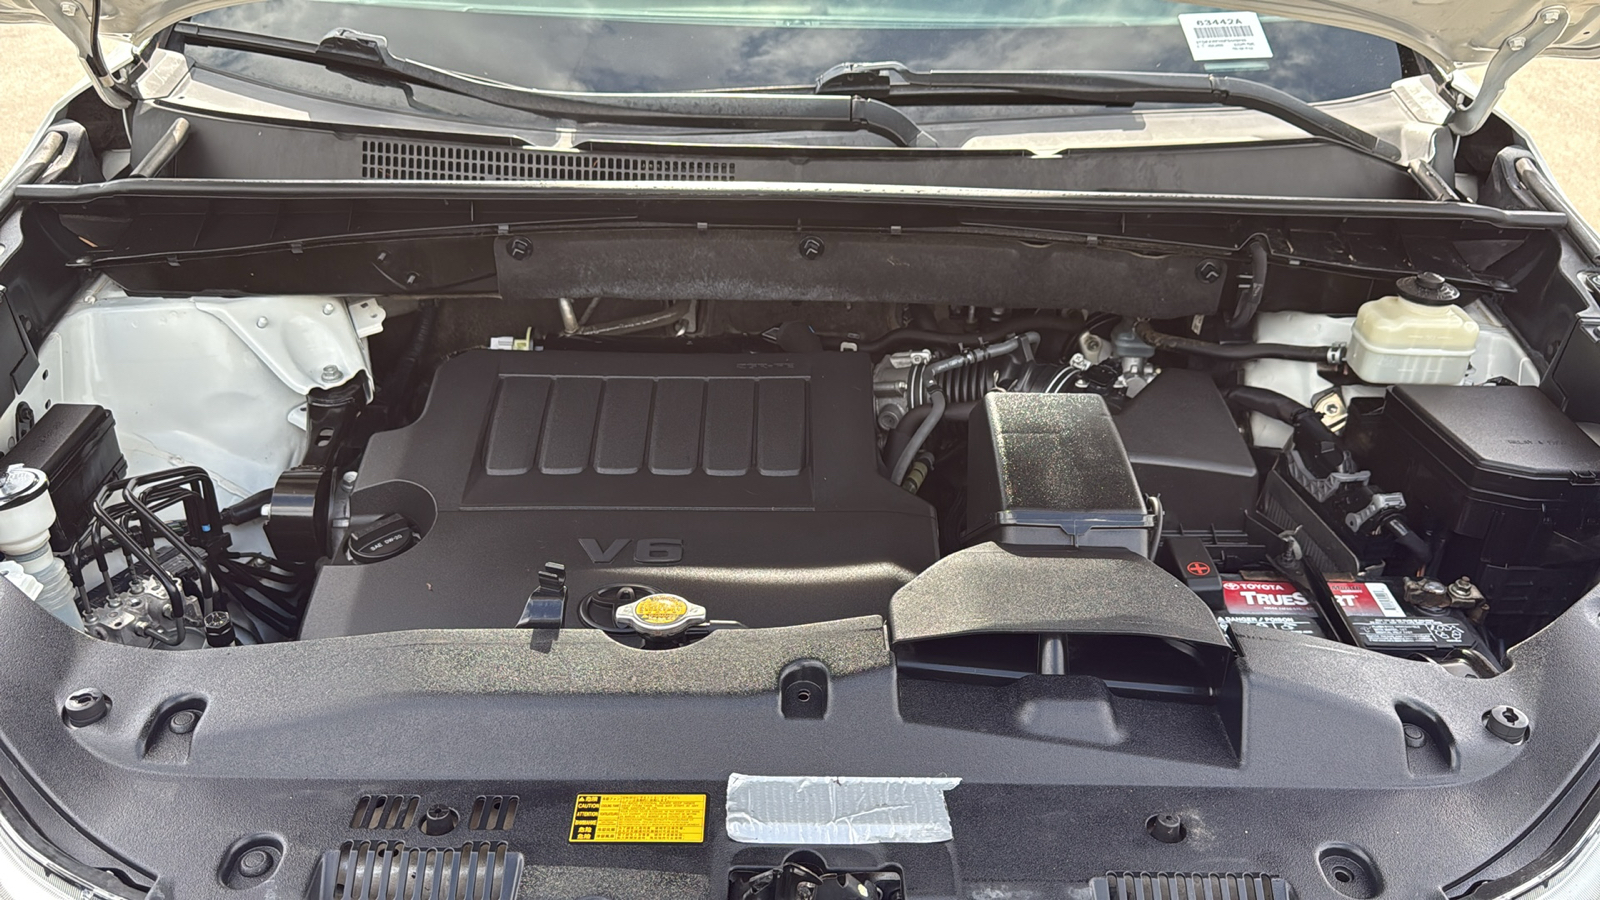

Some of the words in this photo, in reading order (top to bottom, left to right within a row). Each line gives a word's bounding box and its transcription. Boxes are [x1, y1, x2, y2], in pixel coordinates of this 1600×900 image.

[1196, 18, 1243, 26] 63442A
[370, 543, 383, 551] SAE
[578, 538, 684, 565] V6
[1240, 583, 1285, 591] TOYOTA
